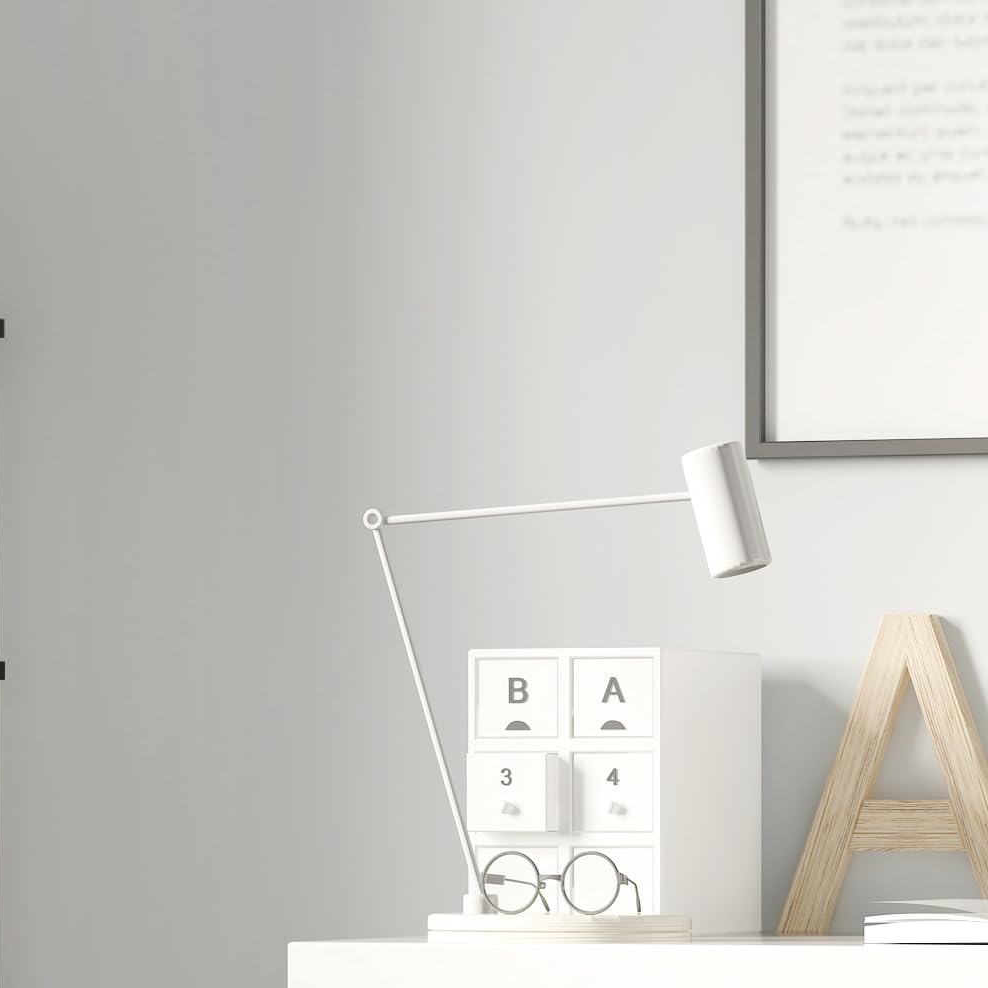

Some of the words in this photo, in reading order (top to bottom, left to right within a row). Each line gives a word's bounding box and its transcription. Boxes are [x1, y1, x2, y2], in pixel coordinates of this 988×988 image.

[508, 677, 529, 704] B
[602, 676, 627, 703] A
[500, 767, 513, 786] 3
[606, 767, 621, 786] 4
